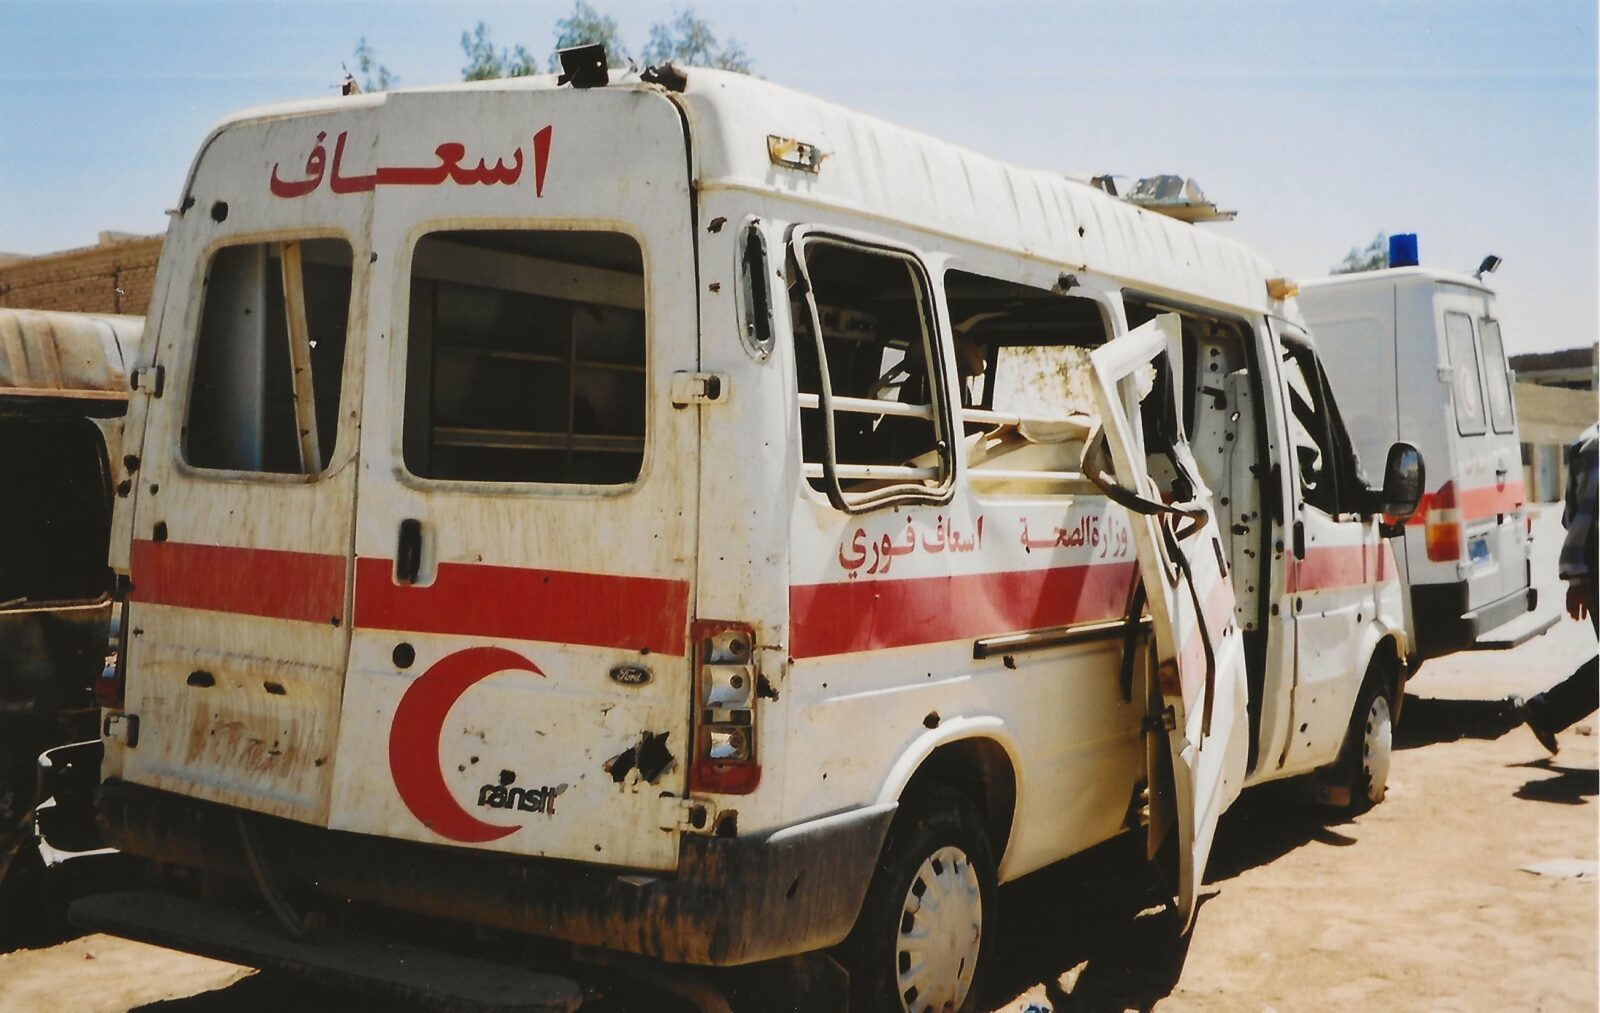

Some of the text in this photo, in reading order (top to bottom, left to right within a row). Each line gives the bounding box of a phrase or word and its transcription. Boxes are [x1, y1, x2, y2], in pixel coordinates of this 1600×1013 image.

[270, 125, 552, 199] اسعاف
[838, 514, 983, 579] اسعاف فوري
[1019, 514, 1128, 558] وزارة الصحة
[616, 668, 643, 682] Ford
